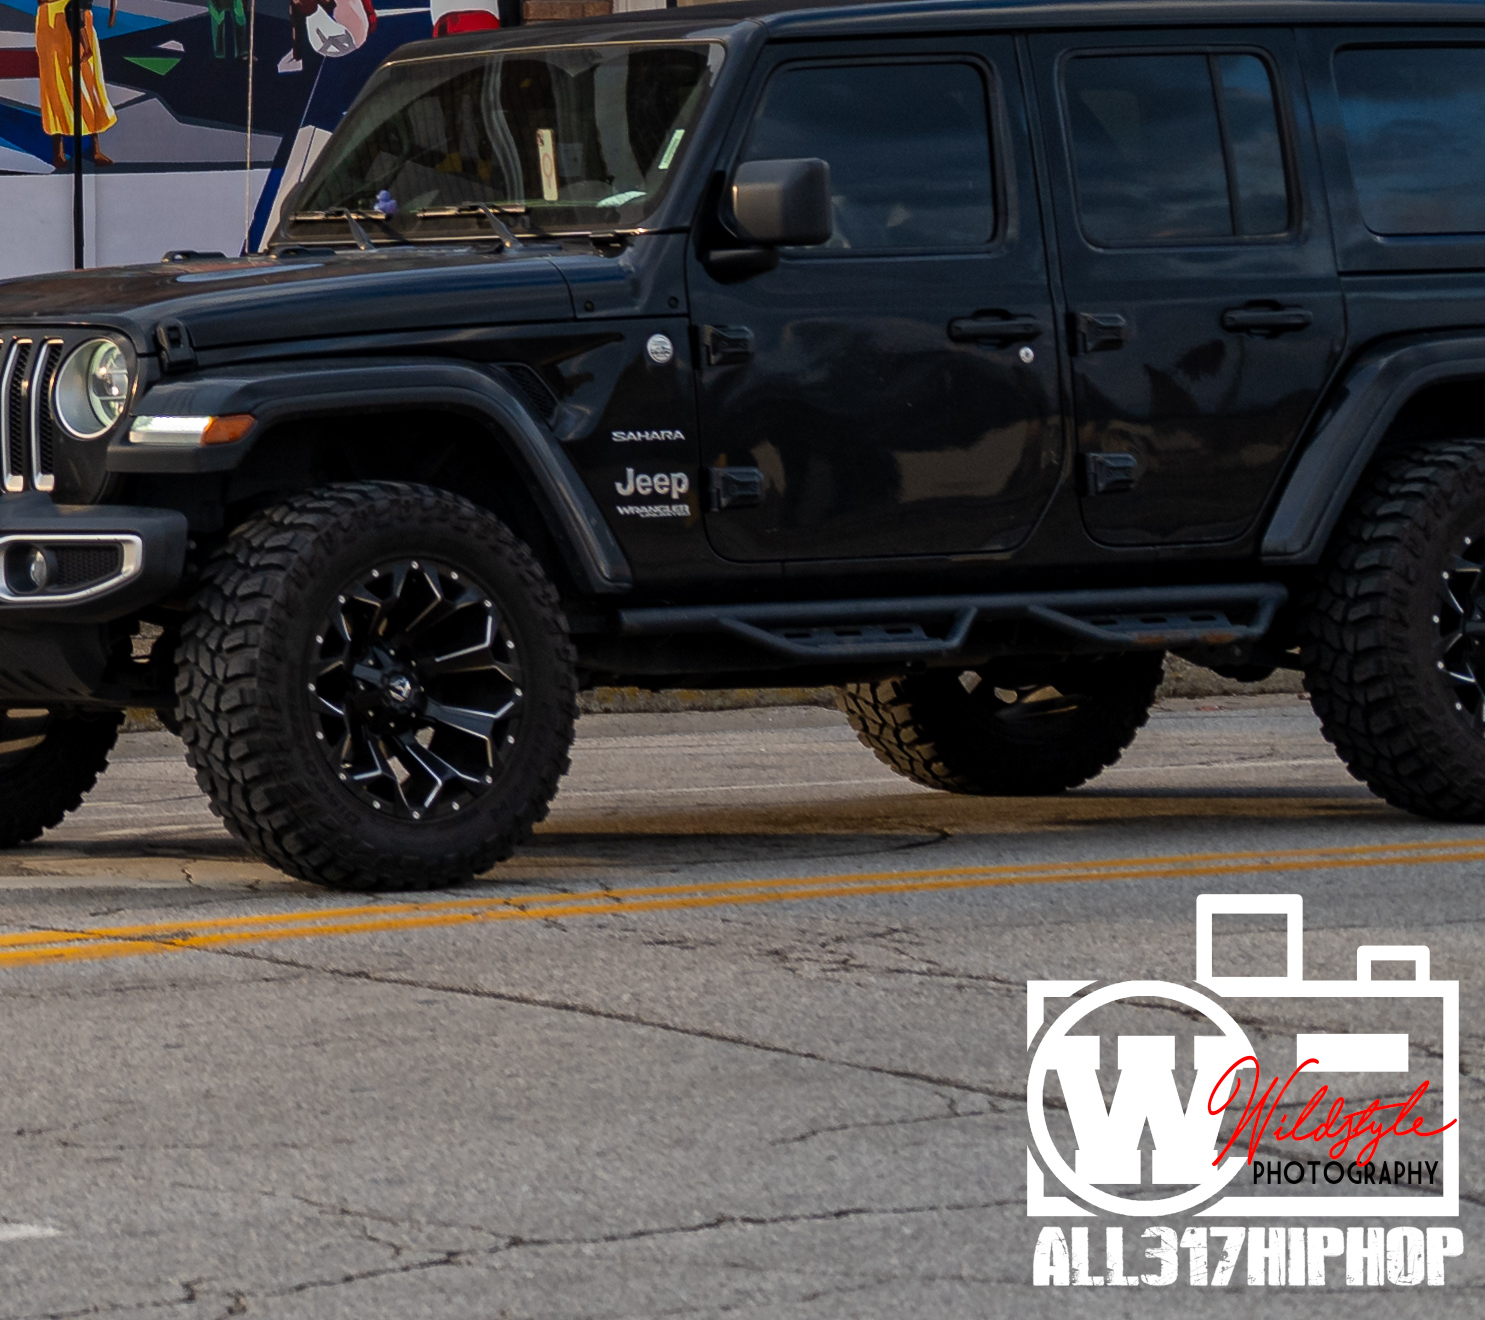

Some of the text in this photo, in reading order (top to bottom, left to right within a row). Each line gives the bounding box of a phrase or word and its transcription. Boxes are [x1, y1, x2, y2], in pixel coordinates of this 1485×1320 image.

[611, 430, 685, 442] SAHARA
[614, 467, 690, 499] Jeep
[616, 504, 690, 515] WRANGLER
